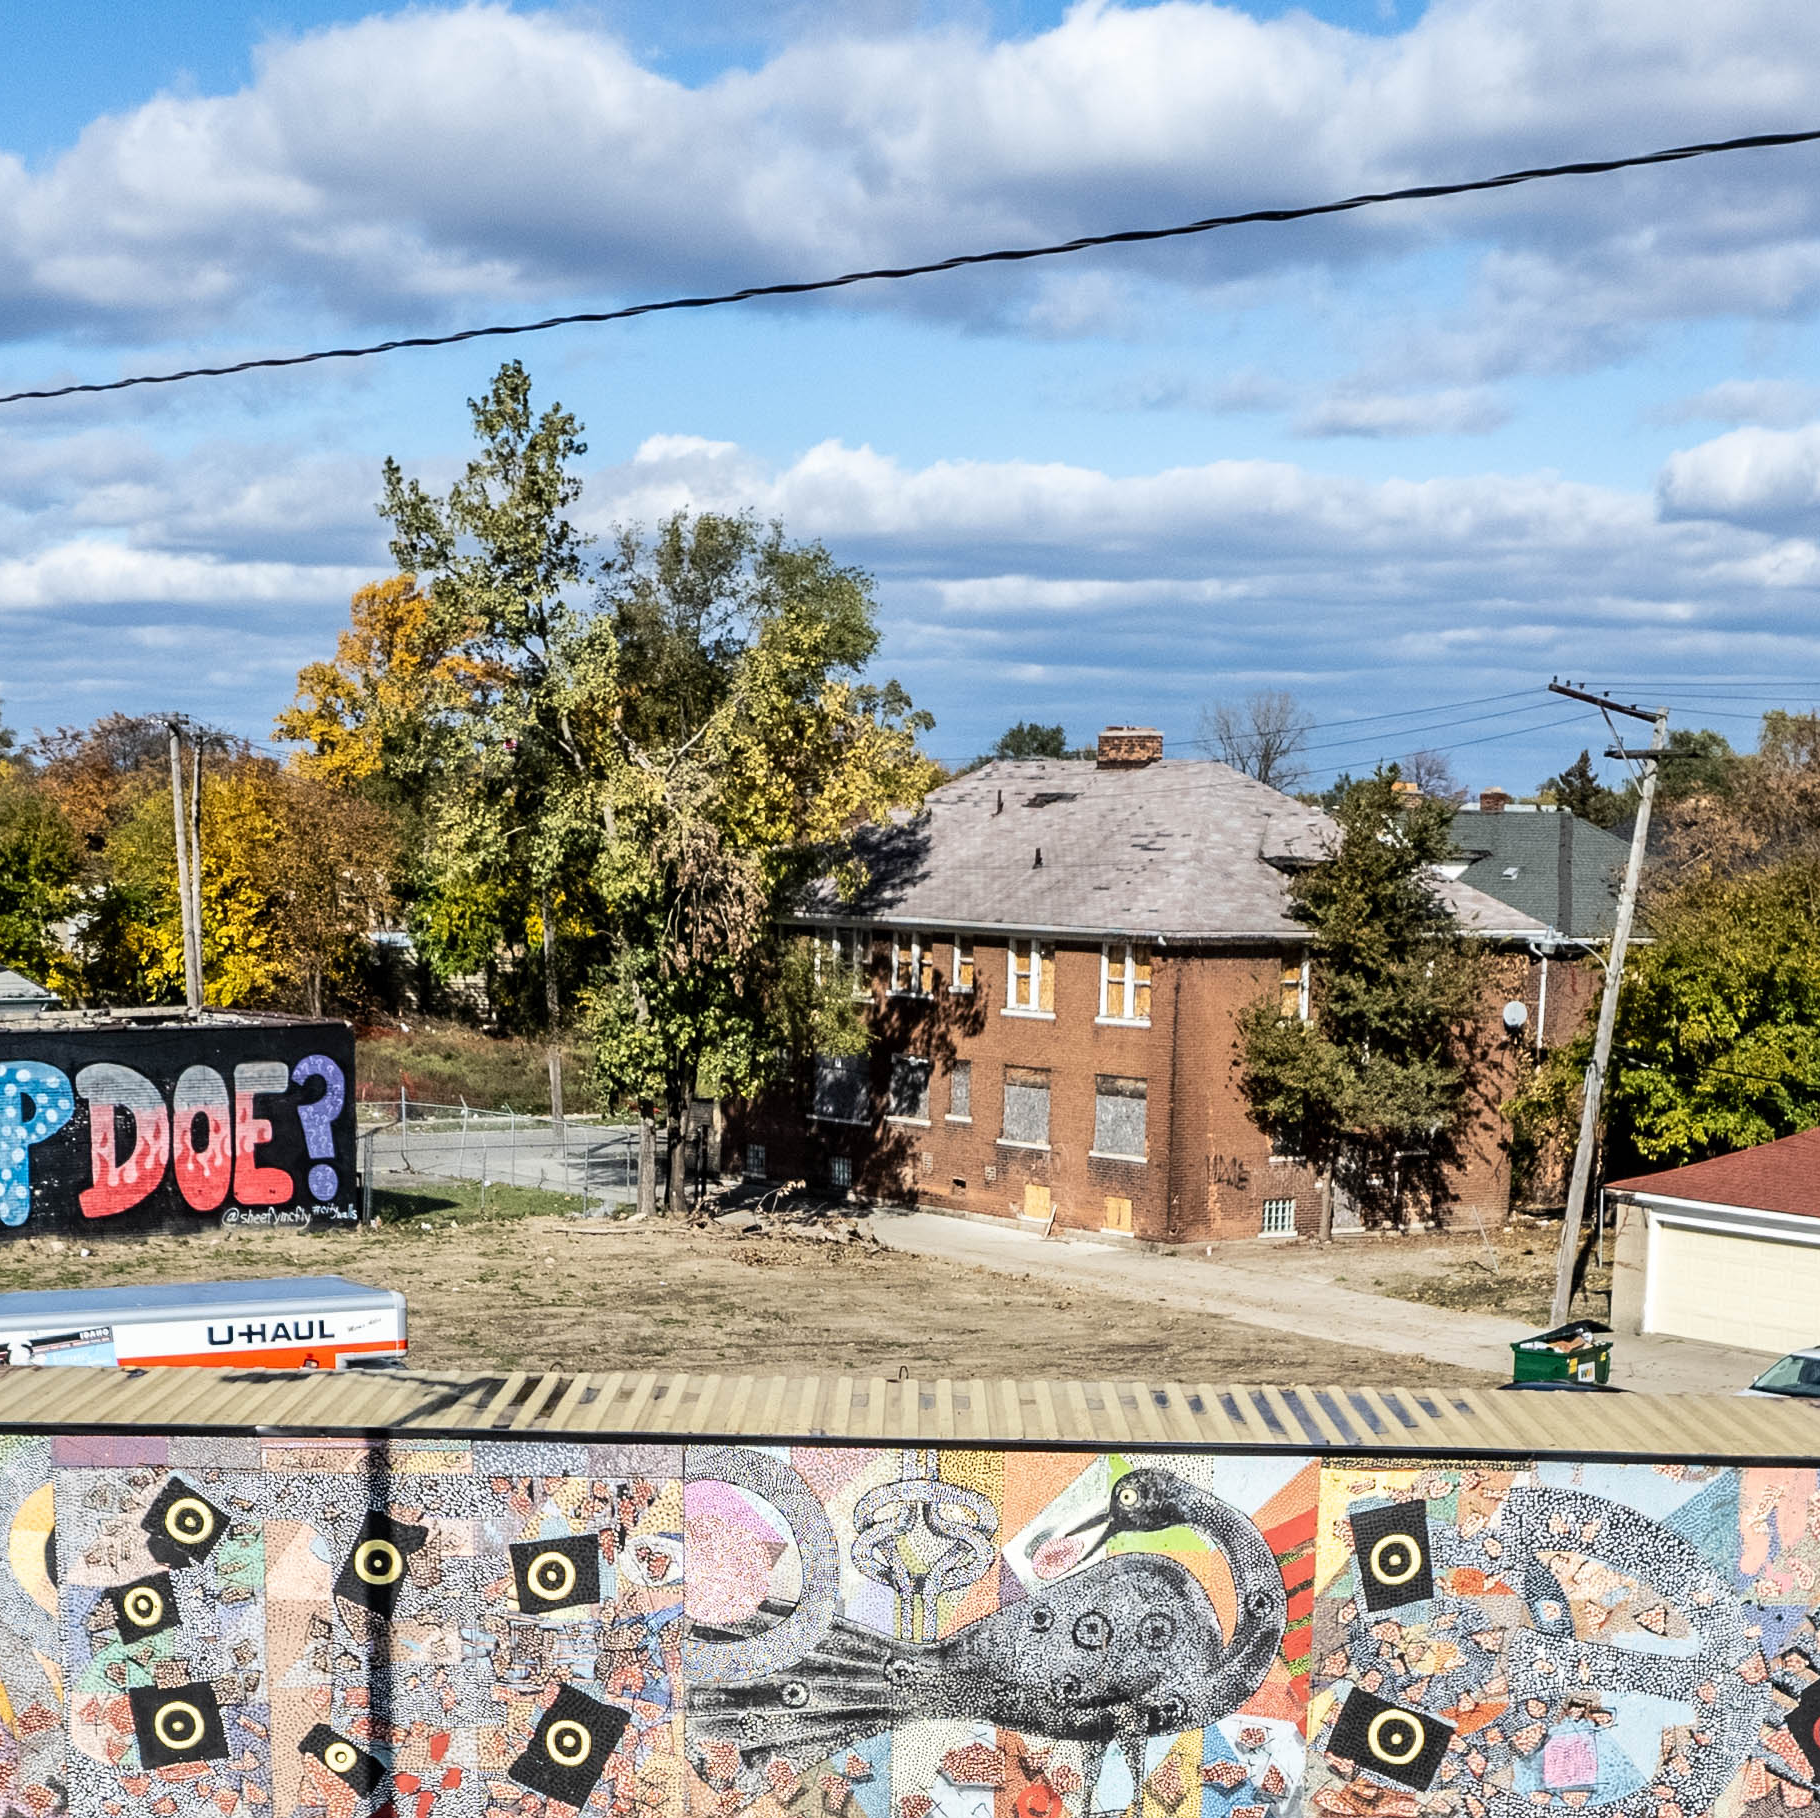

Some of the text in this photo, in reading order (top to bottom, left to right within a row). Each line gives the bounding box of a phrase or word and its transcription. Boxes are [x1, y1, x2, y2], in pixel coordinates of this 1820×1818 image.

[75, 1054, 346, 1219] DOE?
[79, 1326, 110, 1341] IDAHO
[207, 1319, 335, 1346] U-HAUL
